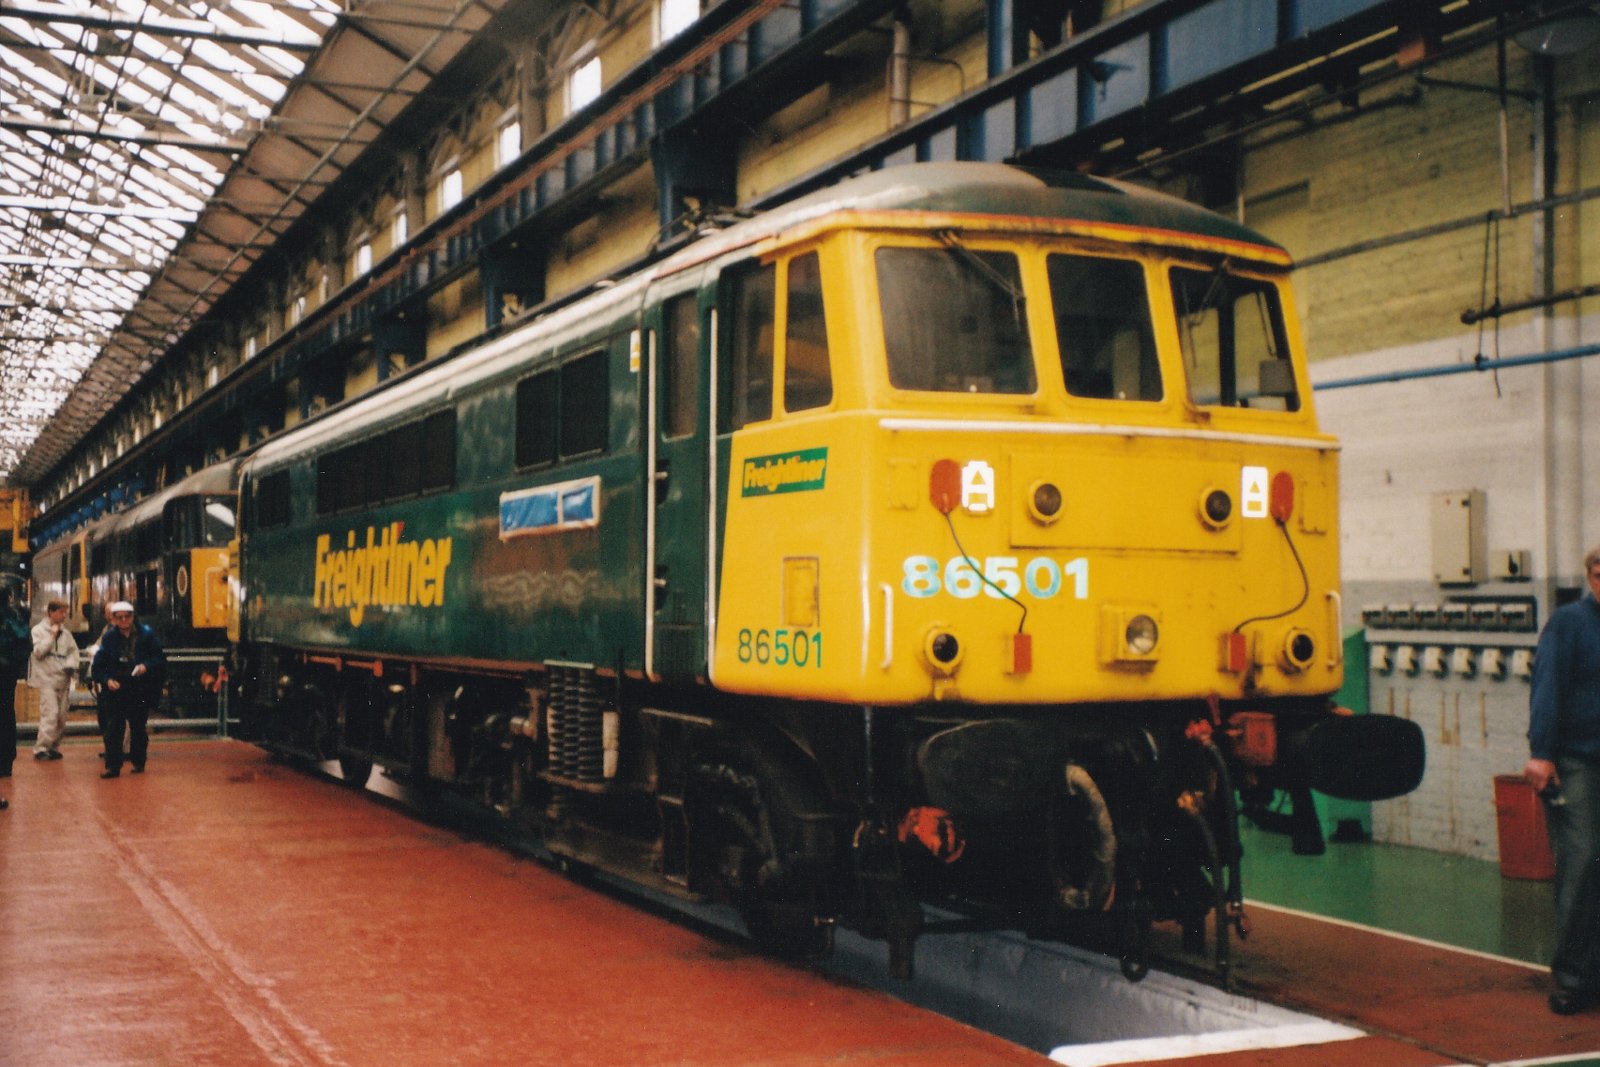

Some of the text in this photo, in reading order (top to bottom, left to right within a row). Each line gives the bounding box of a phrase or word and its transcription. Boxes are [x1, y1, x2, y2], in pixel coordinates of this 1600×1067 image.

[744, 456, 826, 492] Freightliner
[314, 521, 452, 627] Freightliner
[902, 555, 1089, 600] 86501
[738, 628, 822, 668] 86501
